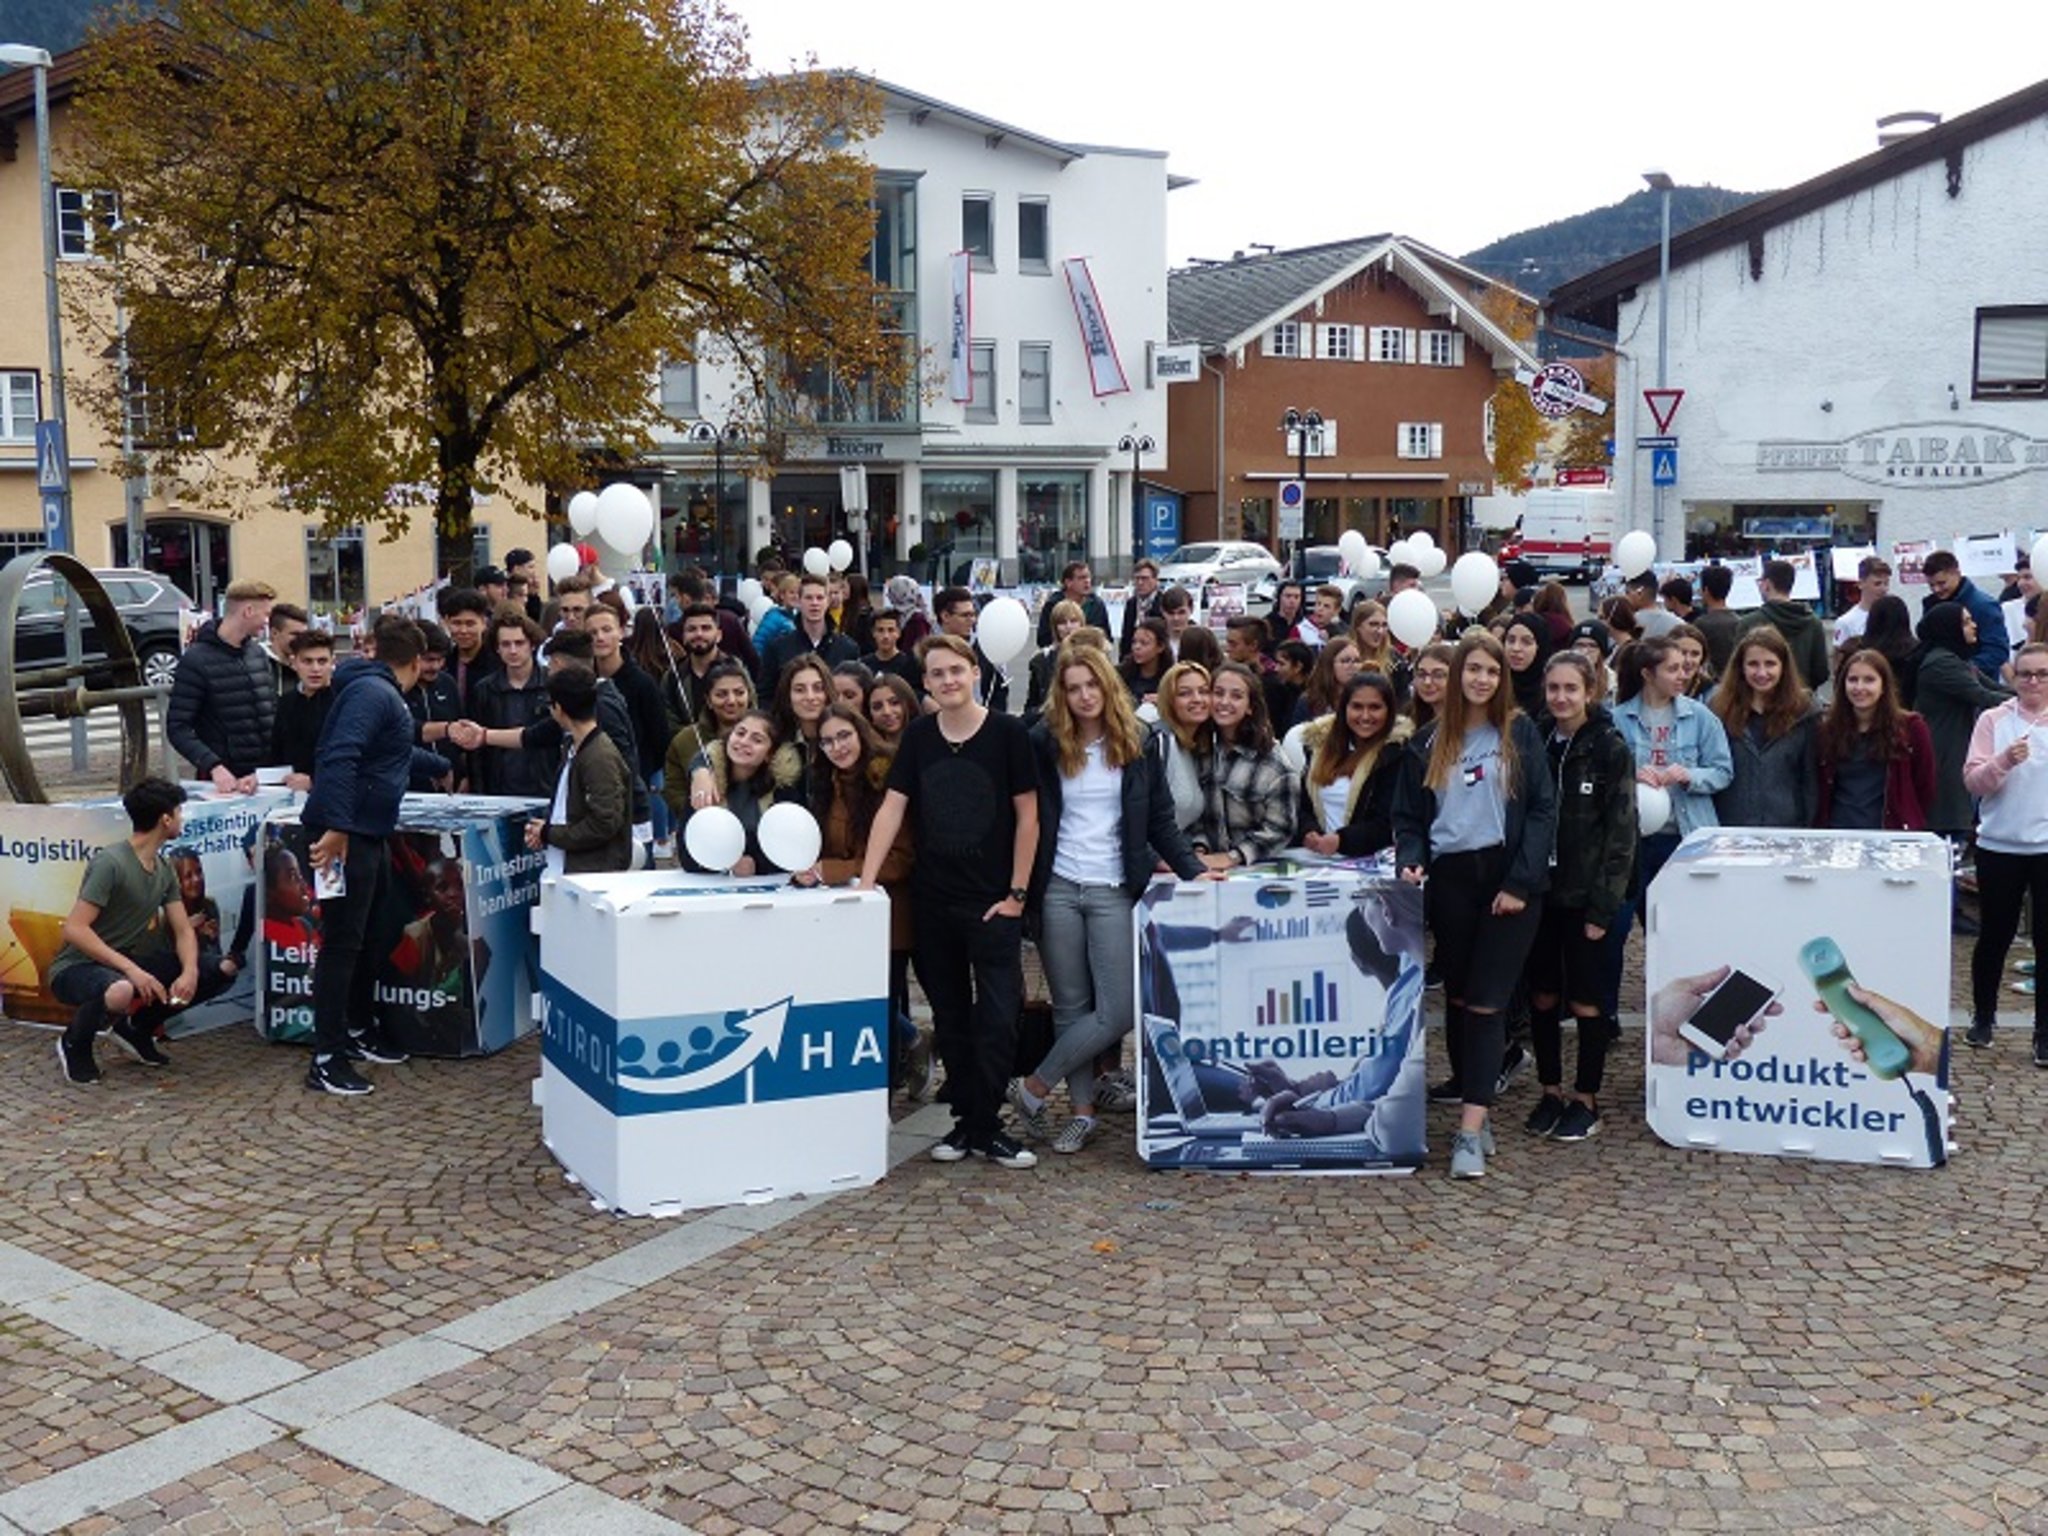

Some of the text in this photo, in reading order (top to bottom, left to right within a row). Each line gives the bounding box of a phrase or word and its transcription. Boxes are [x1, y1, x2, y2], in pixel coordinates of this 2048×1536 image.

[827, 437, 884, 456] FEUCHT
[1856, 435, 2016, 465] TABAK
[1887, 466, 1983, 478] SCHAUER
[1156, 505, 1169, 528] P
[270, 940, 319, 968] Leit
[1685, 1050, 1868, 1089] Produkt-
[1685, 1095, 1906, 1133] entwickler
